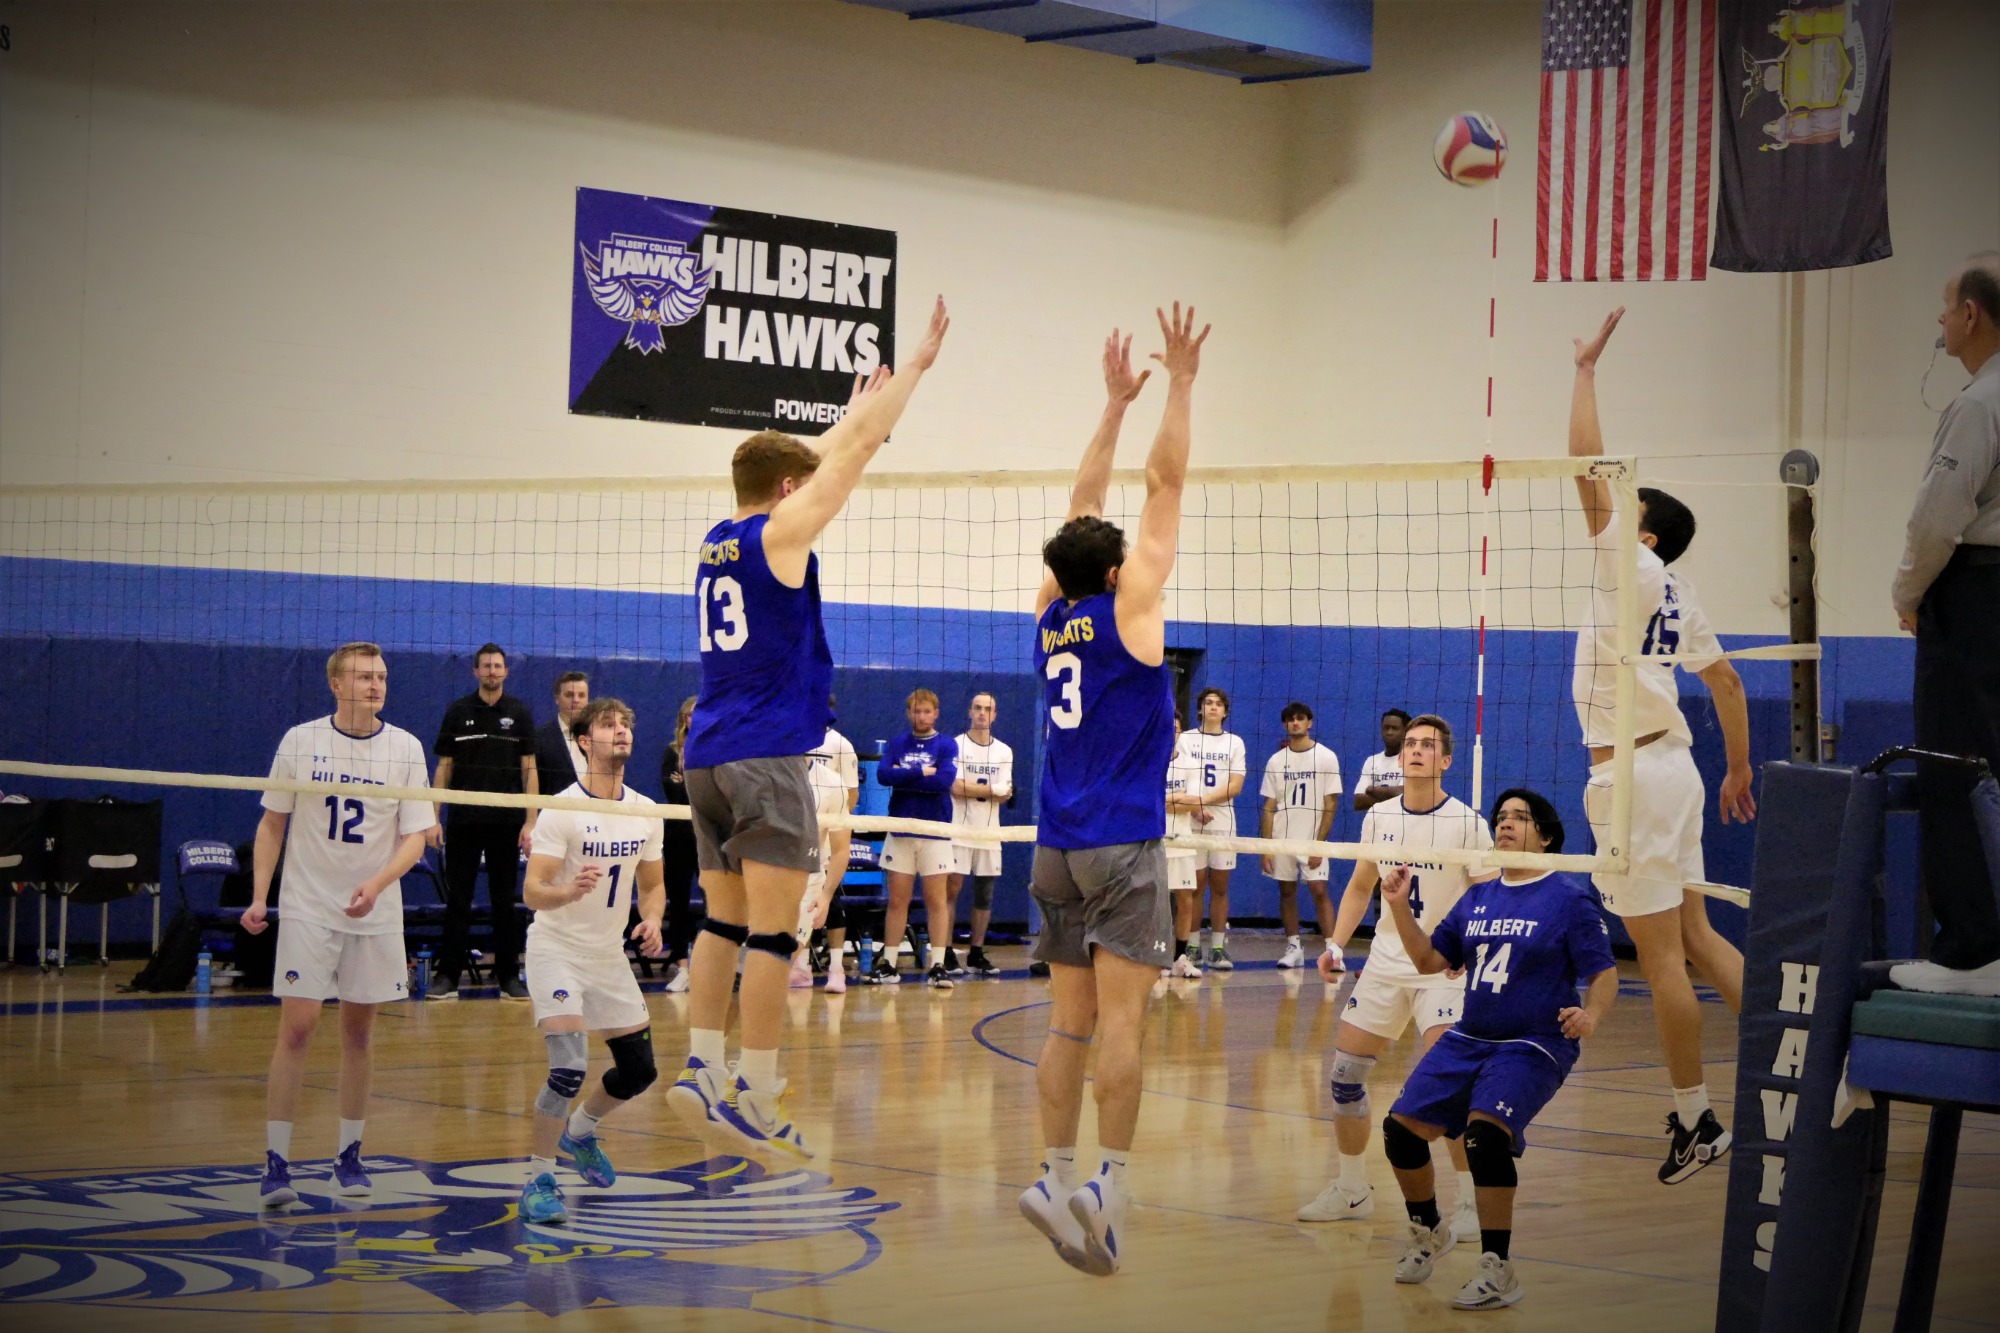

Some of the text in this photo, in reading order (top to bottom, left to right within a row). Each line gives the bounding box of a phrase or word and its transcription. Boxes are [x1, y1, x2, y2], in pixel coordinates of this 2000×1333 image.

[1853, 34, 1865, 98] EXCELSIOR
[615, 239, 683, 255] HILBERT COLLEGE
[602, 247, 695, 290] HAWKS
[701, 234, 891, 309] HILBERT
[704, 305, 881, 376] HAWKS
[710, 406, 741, 415] PROUDLY
[743, 410, 772, 418] SERVING
[699, 576, 749, 652] 13
[1046, 652, 1083, 729] 3
[966, 764, 1000, 776] HILBERT
[1190, 751, 1229, 761] HILBERT
[1204, 764, 1216, 787] 6
[1292, 782, 1306, 805] 11
[325, 795, 364, 844] 12
[186, 846, 232, 856] HILBERT
[190, 855, 232, 865] COLLEGE
[582, 839, 646, 857] HILBERT
[607, 863, 622, 908] 1
[1408, 875, 1424, 918] 4
[1466, 919, 1538, 937] HILBERT
[1471, 943, 1512, 993] 14
